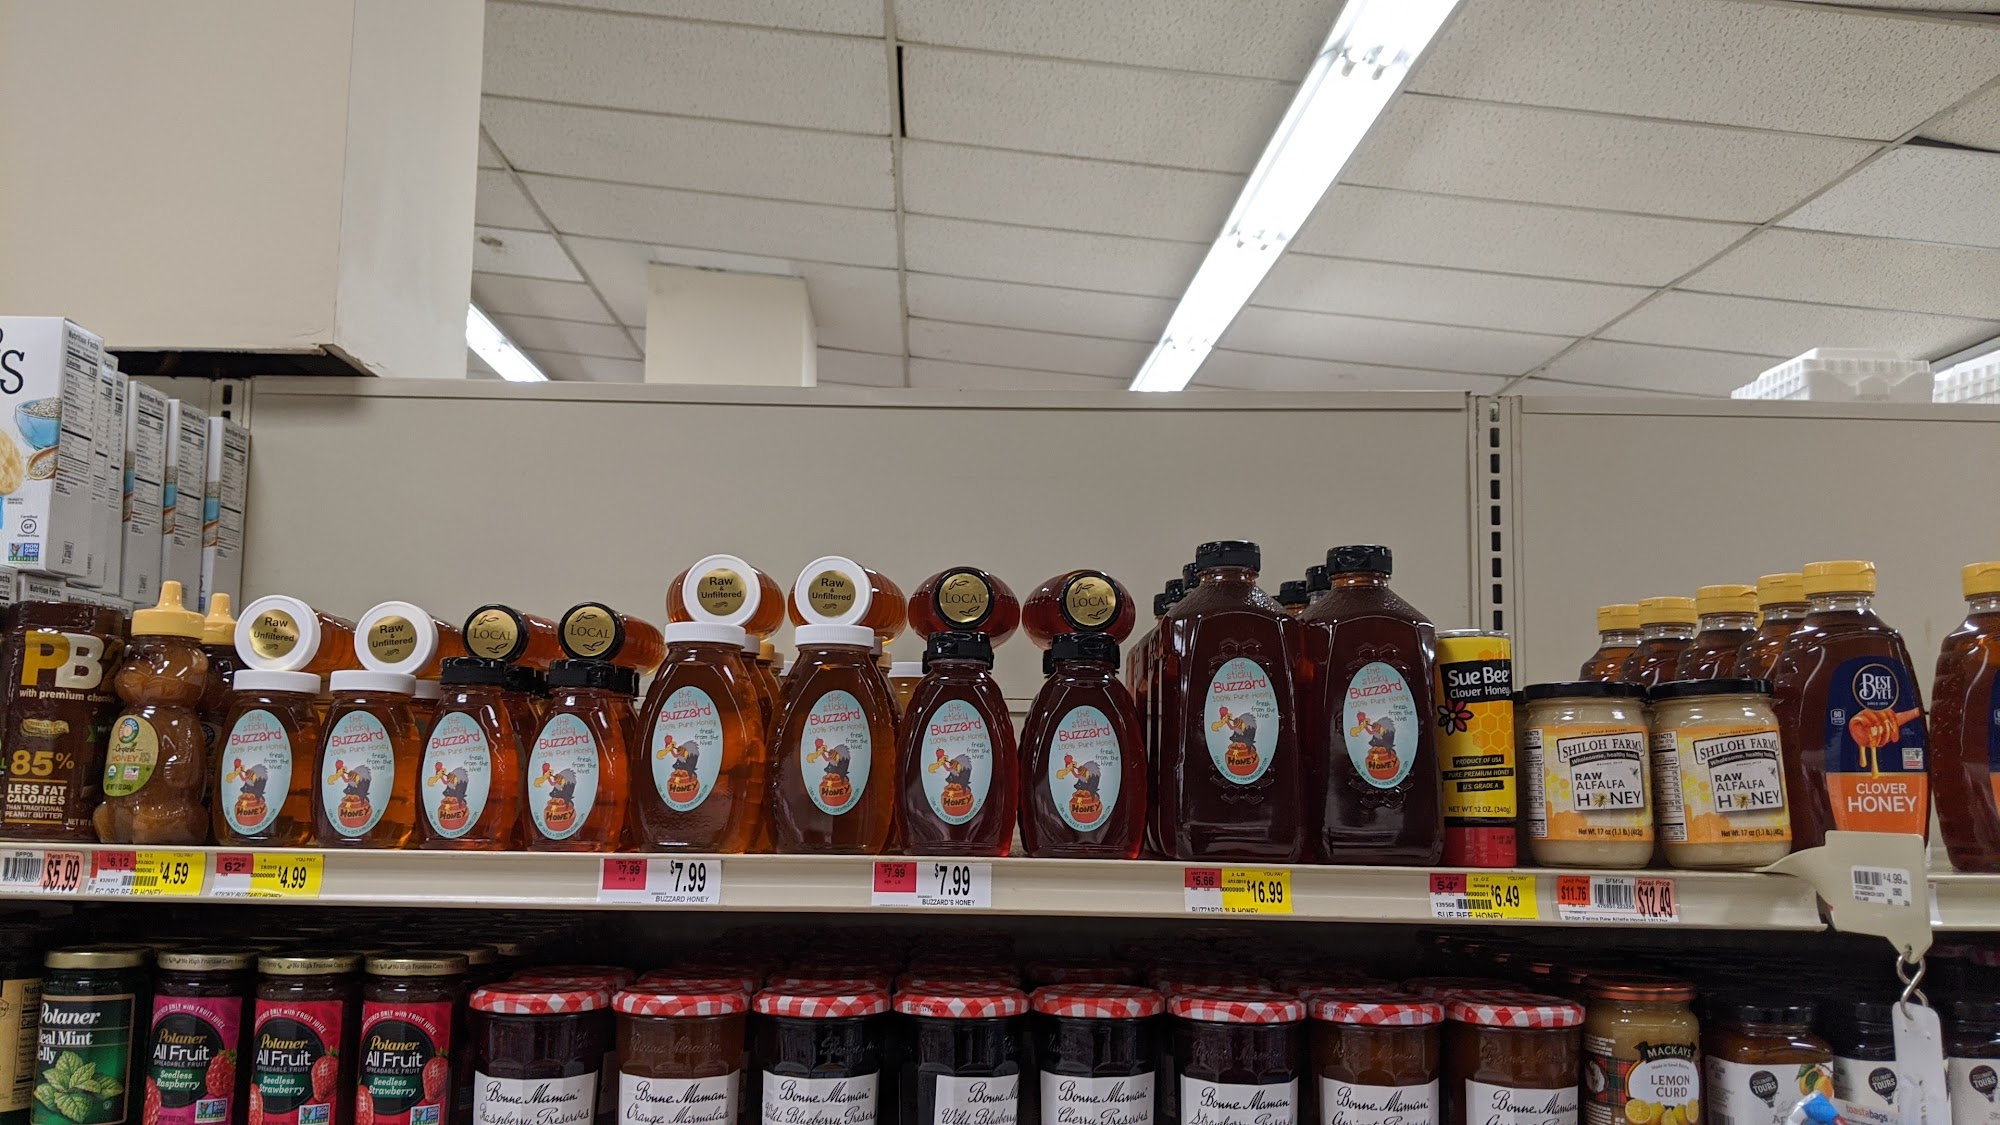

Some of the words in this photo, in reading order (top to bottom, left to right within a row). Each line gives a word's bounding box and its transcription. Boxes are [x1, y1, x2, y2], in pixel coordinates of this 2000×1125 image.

[68, 330, 87, 344] Nutrition
[87, 338, 99, 350] Facts
[0, 349, 25, 395] S
[709, 576, 734, 586] Raw
[821, 578, 845, 588] Raw
[701, 591, 742, 599] Unfiltered
[812, 592, 852, 601] Unfiltered
[945, 592, 985, 604] LOCAL
[1071, 596, 1112, 608] LOCAL
[264, 616, 288, 628] Raw
[379, 624, 404, 634] Raw
[253, 630, 295, 642] Unfiltered
[473, 628, 513, 641] LOCAL
[570, 624, 610, 639] LOCAL
[372, 637, 413, 648] Unfiltered
[1213, 675, 1267, 694] Buzzard
[1447, 669, 1482, 687] Sue
[1482, 666, 1509, 684] Bee
[20, 688, 37, 698] with
[39, 690, 84, 701] premium
[1349, 679, 1403, 700] Buzzard
[1450, 688, 1482, 699] Clover
[1484, 685, 1510, 697] Honey
[660, 703, 712, 723] Buzzard
[809, 707, 861, 726] Buzzard
[930, 716, 982, 736] Buzzard
[1058, 723, 1111, 742] Buzzard
[231, 726, 283, 746] Buzzard
[331, 727, 384, 747] Buzzard
[431, 729, 481, 749] Buzzard
[539, 731, 590, 750] Buzzard
[1562, 740, 1607, 759] SHILOH
[1612, 738, 1644, 752] FARMS
[1700, 739, 1747, 760] SHILOH
[1750, 737, 1779, 752] FARMS
[10, 749, 75, 777] 85%
[1227, 754, 1257, 766] HONEY
[1368, 757, 1398, 770] HONEY
[1463, 770, 1492, 778] PREMIUM
[1575, 772, 1603, 781] RAW
[1714, 772, 1742, 783] RAW
[7, 783, 40, 795] LESS
[43, 785, 67, 796] FAT
[669, 781, 698, 793] HONEY
[821, 784, 850, 796] HONEY
[1576, 779, 1626, 790] ALFALFA
[1716, 779, 1765, 792] ALFALFA
[1856, 783, 1907, 794] CLOVER
[7, 794, 66, 805] CALORIES
[943, 795, 972, 806] HONEY
[1577, 790, 1641, 807] HNEY
[1717, 790, 1780, 808] HNEY
[1848, 796, 1917, 812] HONEY
[32, 811, 63, 819] BUTTER
[1072, 802, 1101, 813] HONEY
[43, 859, 79, 892] $5.99
[160, 862, 189, 885] $4.59
[277, 866, 307, 889] $4.99
[619, 864, 640, 875] $7.99
[670, 859, 706, 892] $7.99
[884, 868, 905, 878] $7.99
[935, 863, 970, 896] $7.99
[1882, 873, 1903, 885] $4.99
[655, 895, 685, 903] BUZZARD
[1246, 880, 1283, 904] $16.99
[1490, 884, 1520, 907] $6.49
[1561, 886, 1586, 901] $11.76
[1638, 886, 1673, 918] $12.49
[39, 1001, 100, 1025] Polaner
[39, 1029, 56, 1045] eal
[57, 1031, 93, 1046] Mint
[159, 1028, 206, 1045] Polaner
[260, 1033, 308, 1050] Polaner
[370, 1034, 419, 1052] Polaner
[37, 1046, 57, 1065] elly
[153, 1044, 167, 1060] All
[170, 1044, 210, 1061] Fruit
[256, 1049, 268, 1066] All
[271, 1051, 312, 1067] Fruit
[365, 1051, 379, 1067] All
[383, 1052, 422, 1068] Fruit
[1647, 1046, 1691, 1058] MACKAYS
[159, 1070, 192, 1080] Seedless
[263, 1075, 295, 1085] Seedless
[373, 1077, 407, 1087] Seedless
[1650, 1074, 1690, 1086] LEMON
[1973, 1076, 1997, 1089] TOURS
[156, 1078, 200, 1090] Raspberry
[259, 1083, 305, 1096] Strawberry
[368, 1085, 416, 1097] Strawberry
[779, 1079, 820, 1103] Bonne
[822, 1081, 870, 1103] Maman
[967, 1081, 1004, 1103] Bonne
[1059, 1079, 1100, 1103] Bonne
[1101, 1081, 1147, 1103] Maman
[1753, 1082, 1777, 1093] TOURS
[1872, 1078, 1896, 1090] TOURS
[485, 1080, 522, 1104] Bonne
[524, 1082, 578, 1105] Maman
[634, 1081, 673, 1104] Bonne
[675, 1083, 727, 1104] Maman
[1200, 1086, 1242, 1110] Bonne
[1243, 1089, 1290, 1110] Maman
[1336, 1086, 1377, 1112] Bonne
[1379, 1090, 1429, 1113] Maman
[1656, 1087, 1688, 1098] CURD
[1492, 1089, 1537, 1114] Bonne
[1539, 1091, 1578, 1115] Maman
[536, 1107, 590, 1125] Preserves
[625, 1102, 664, 1124] Orange
[1057, 1107, 1097, 1125] Cherry
[1845, 1103, 1889, 1123] toastabags
